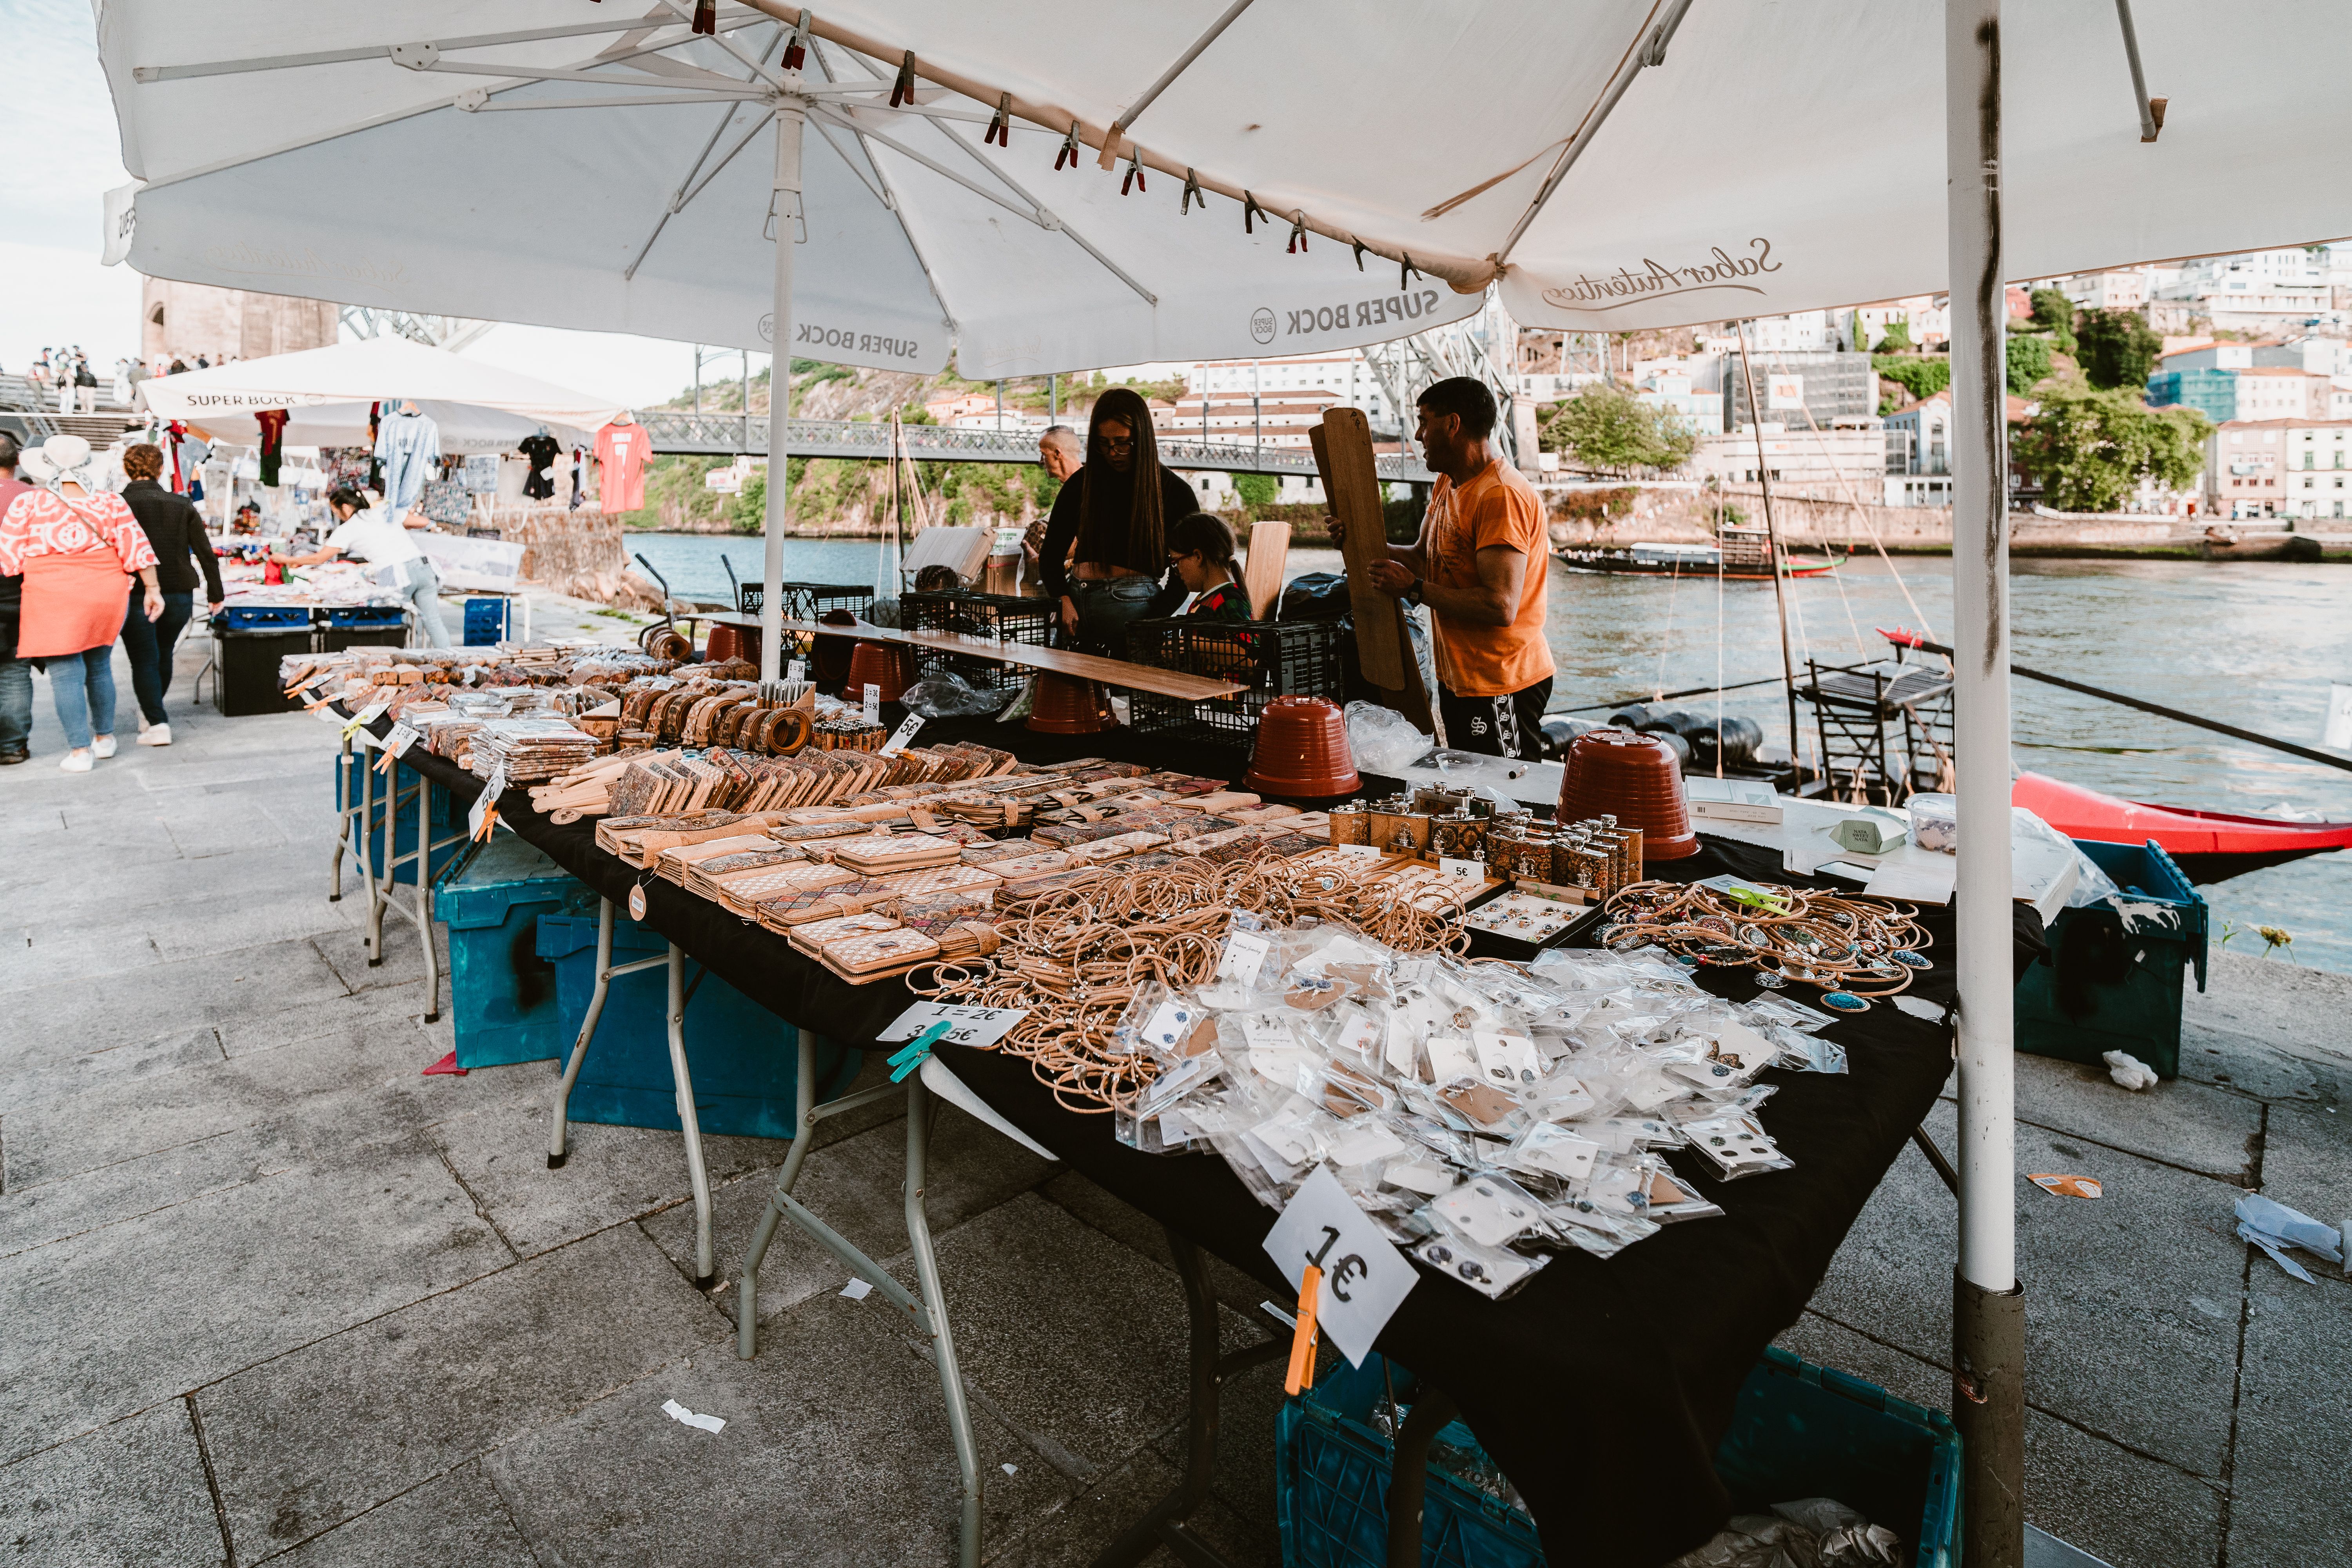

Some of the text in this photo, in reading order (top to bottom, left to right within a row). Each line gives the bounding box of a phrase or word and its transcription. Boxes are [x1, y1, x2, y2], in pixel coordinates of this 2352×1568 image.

[187, 395, 243, 406] SUPER
[249, 395, 296, 405] BOCK
[900, 718, 919, 737] 5€
[482, 783, 495, 811] 5€
[1456, 867, 1468, 877] 5€
[1232, 941, 1261, 955] Fashion Jewelry
[931, 1006, 949, 1016] 1
[968, 1009, 1002, 1020] 2€
[907, 1024, 978, 1041] 3 5€
[1305, 1223, 1368, 1303] 1€
